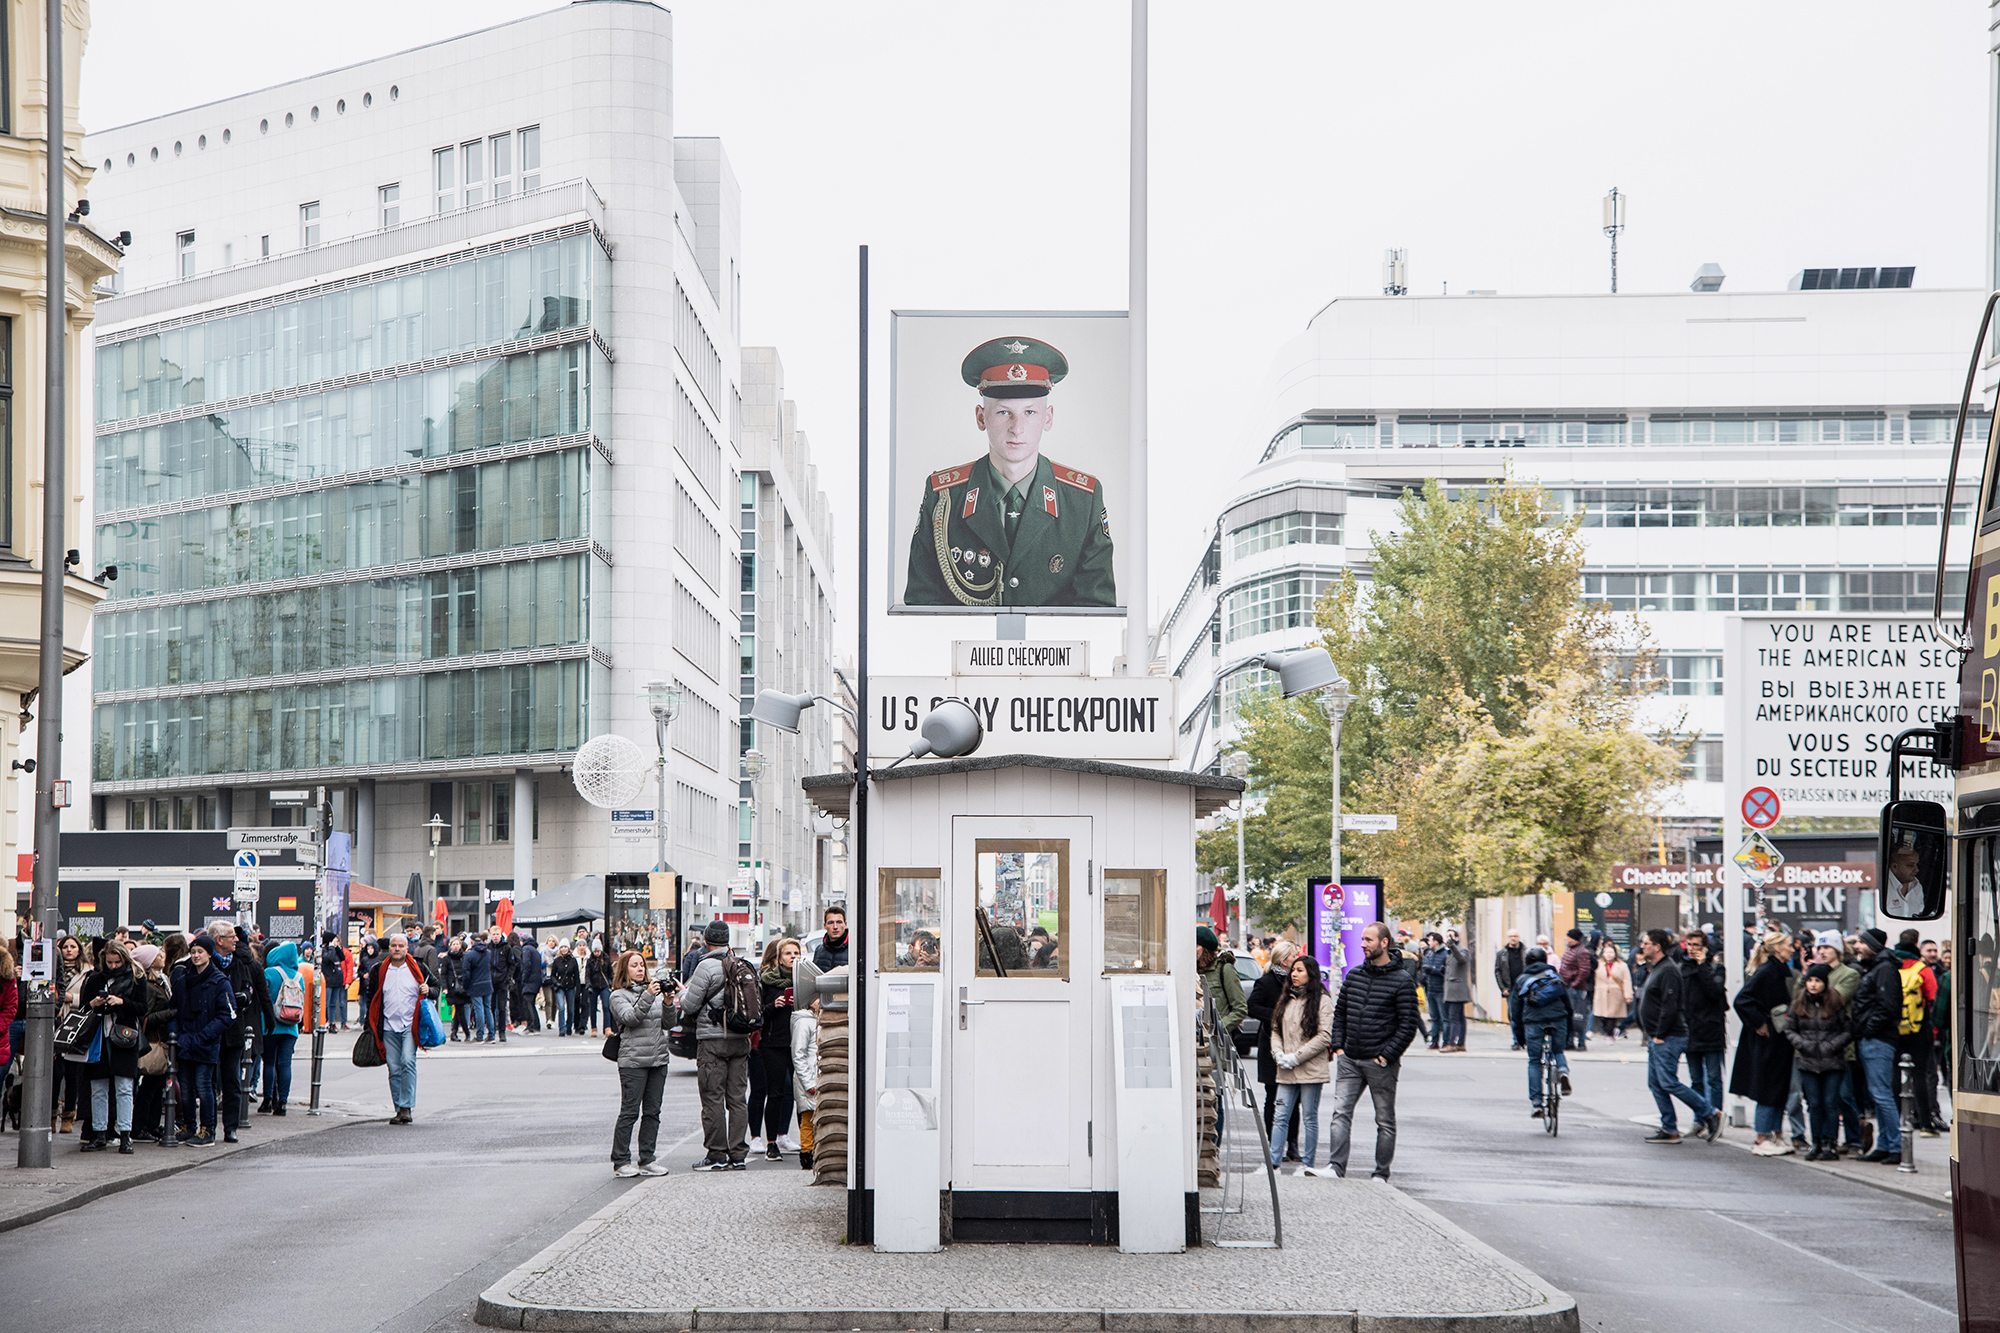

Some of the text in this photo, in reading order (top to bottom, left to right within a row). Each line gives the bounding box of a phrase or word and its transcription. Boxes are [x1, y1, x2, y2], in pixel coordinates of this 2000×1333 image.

[1770, 624, 1814, 643] YOU
[1829, 624, 1871, 643] ARE
[970, 646, 1072, 667] ALLIED CHECKPOINT
[1759, 649, 1791, 667] THE
[1803, 649, 1906, 667] AMERICAN
[1762, 680, 1946, 699] ВЫ ВЫЕЗЖАЕТЕ
[881, 696, 896, 732] U
[904, 696, 918, 731] S
[1010, 697, 1159, 733] CHECKPOINT
[1756, 703, 1909, 722] АМЕРИКАНСКОГО
[1788, 733, 1850, 752] VOUS
[1757, 758, 1781, 777] DU
[1790, 758, 1877, 778] SECTEUR
[1837, 788, 1857, 802] DEN
[240, 832, 299, 844] Zimmerstraße
[614, 826, 652, 835] Zimmerstraße
[1783, 865, 1864, 884] BlackBox
